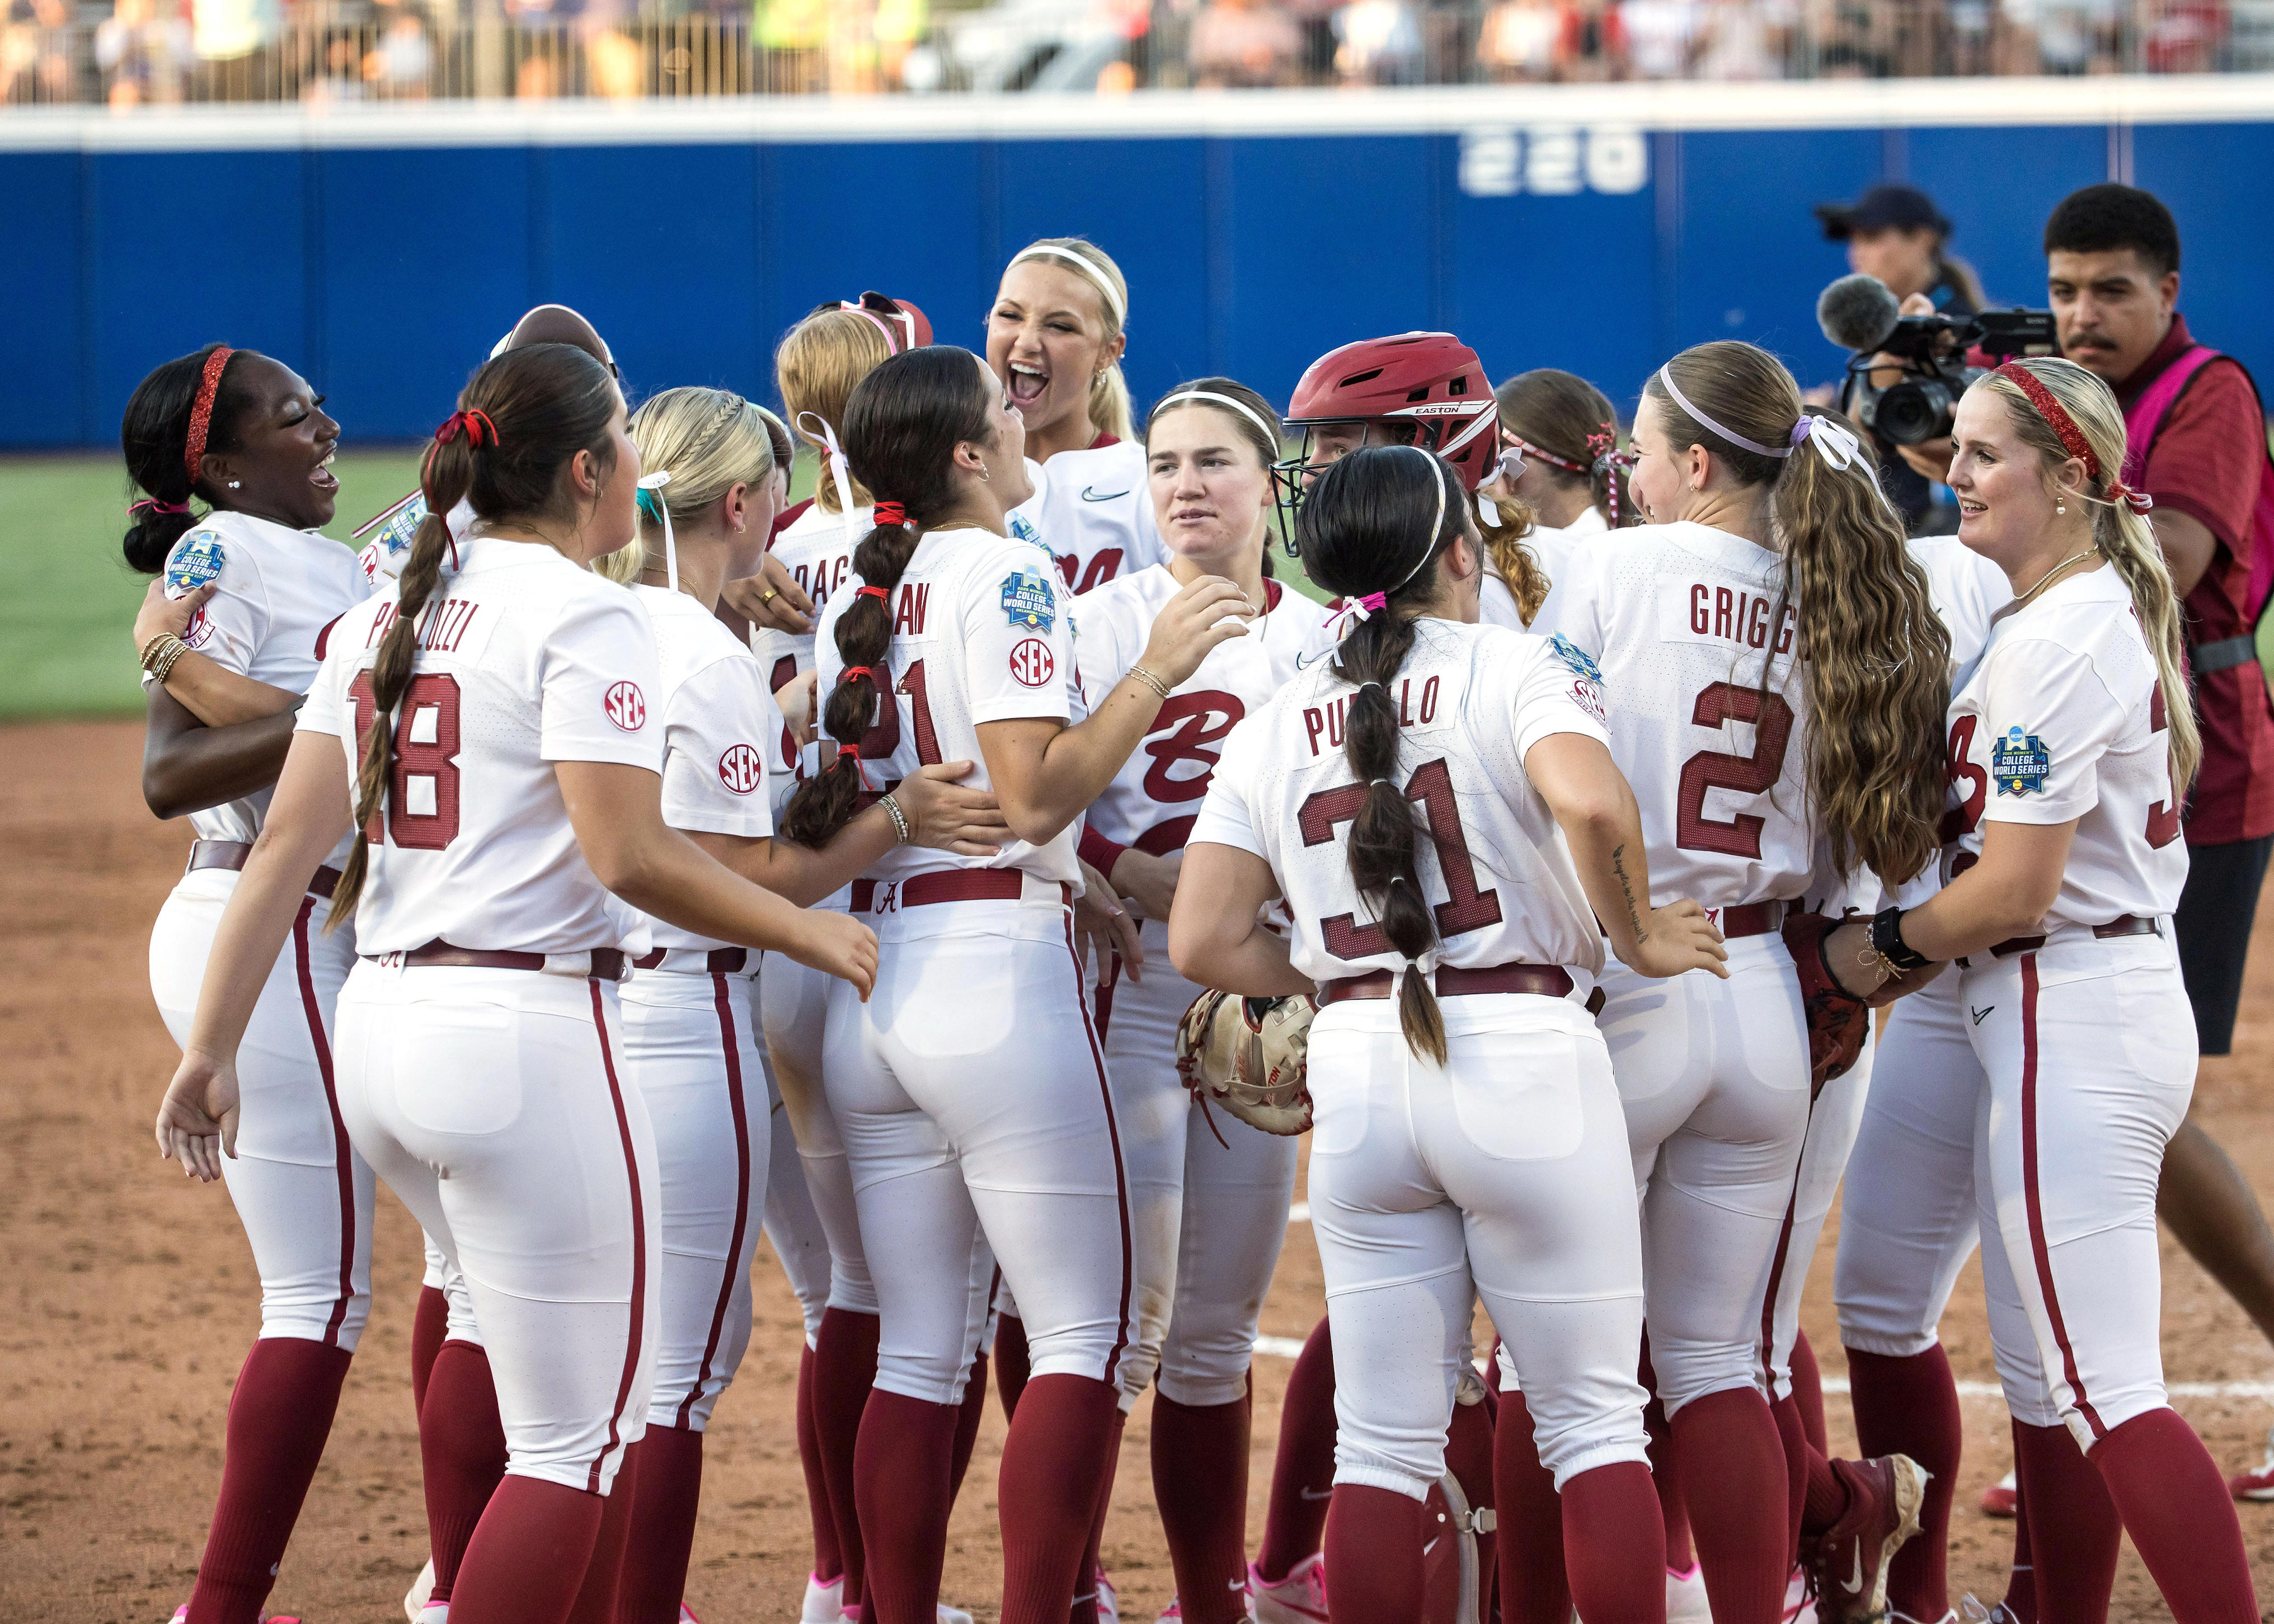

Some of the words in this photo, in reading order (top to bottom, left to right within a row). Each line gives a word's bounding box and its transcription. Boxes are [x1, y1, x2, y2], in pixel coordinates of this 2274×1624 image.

[1459, 124, 1648, 196] 220
[170, 563, 192, 572] WORLD
[190, 565, 219, 578] SERIES
[181, 556, 212, 568] COLLEGE
[1003, 598, 1032, 610] WORLD
[1033, 604, 1054, 617] SERIES
[1016, 591, 1047, 605] COLLEGE
[365, 599, 479, 652] PALOZZI
[1690, 583, 1810, 661] GRIGG
[1012, 641, 1051, 684] SEC
[605, 681, 644, 730] SEC
[1303, 675, 1439, 757] PULO
[719, 745, 760, 793] SEC
[1676, 681, 1794, 860] 2
[1994, 766, 2017, 775] WORLD
[2018, 765, 2047, 774] SERIES
[2002, 755, 2035, 765] COLLEGE
